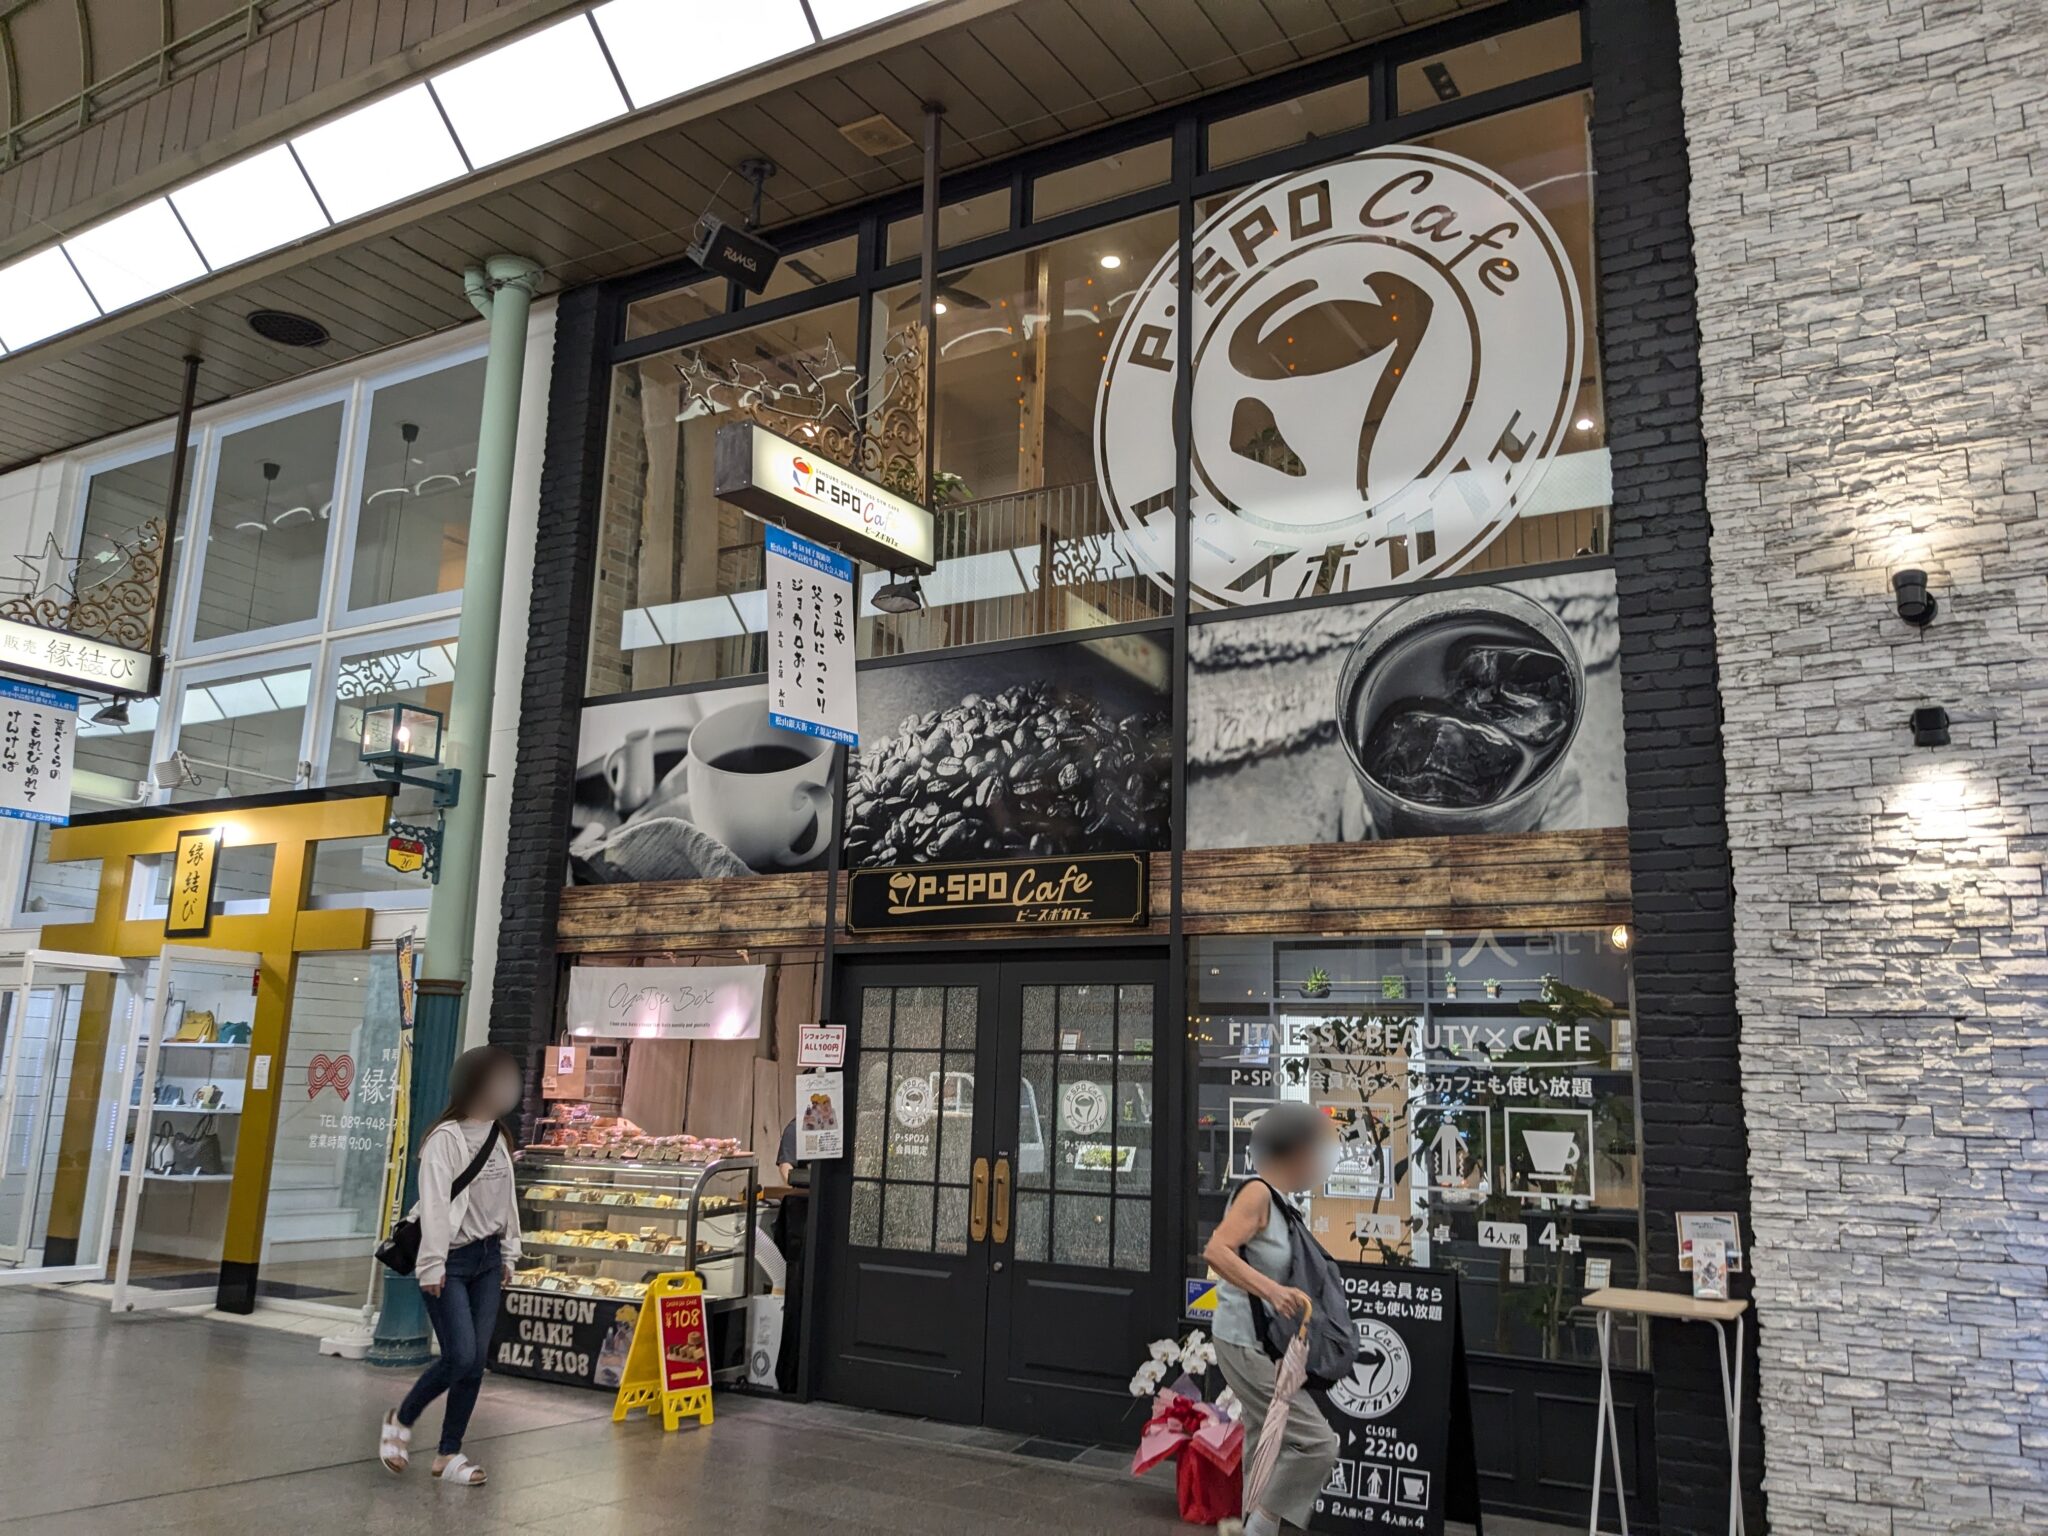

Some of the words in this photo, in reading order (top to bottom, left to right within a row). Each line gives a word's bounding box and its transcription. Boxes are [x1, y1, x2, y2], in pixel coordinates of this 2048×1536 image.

[1358, 170, 1520, 297] Cafe
[724, 247, 757, 272] RAMSA
[44, 639, 136, 679] 縁結び
[181, 842, 205, 922] 縁結び
[1012, 864, 1093, 906] Cafe
[673, 985, 716, 1012] Box
[319, 1114, 337, 1129] TEL
[308, 1134, 346, 1150] 営業時間
[505, 1292, 598, 1325] CHIFFON
[1188, 1309, 1214, 1318] ALSO
[519, 1320, 574, 1347] CAKE
[497, 1342, 535, 1367] ALL
[541, 1348, 590, 1377] ¥108
[1365, 1424, 1398, 1439] CLOSE
[1364, 1438, 1419, 1462] 22:00
